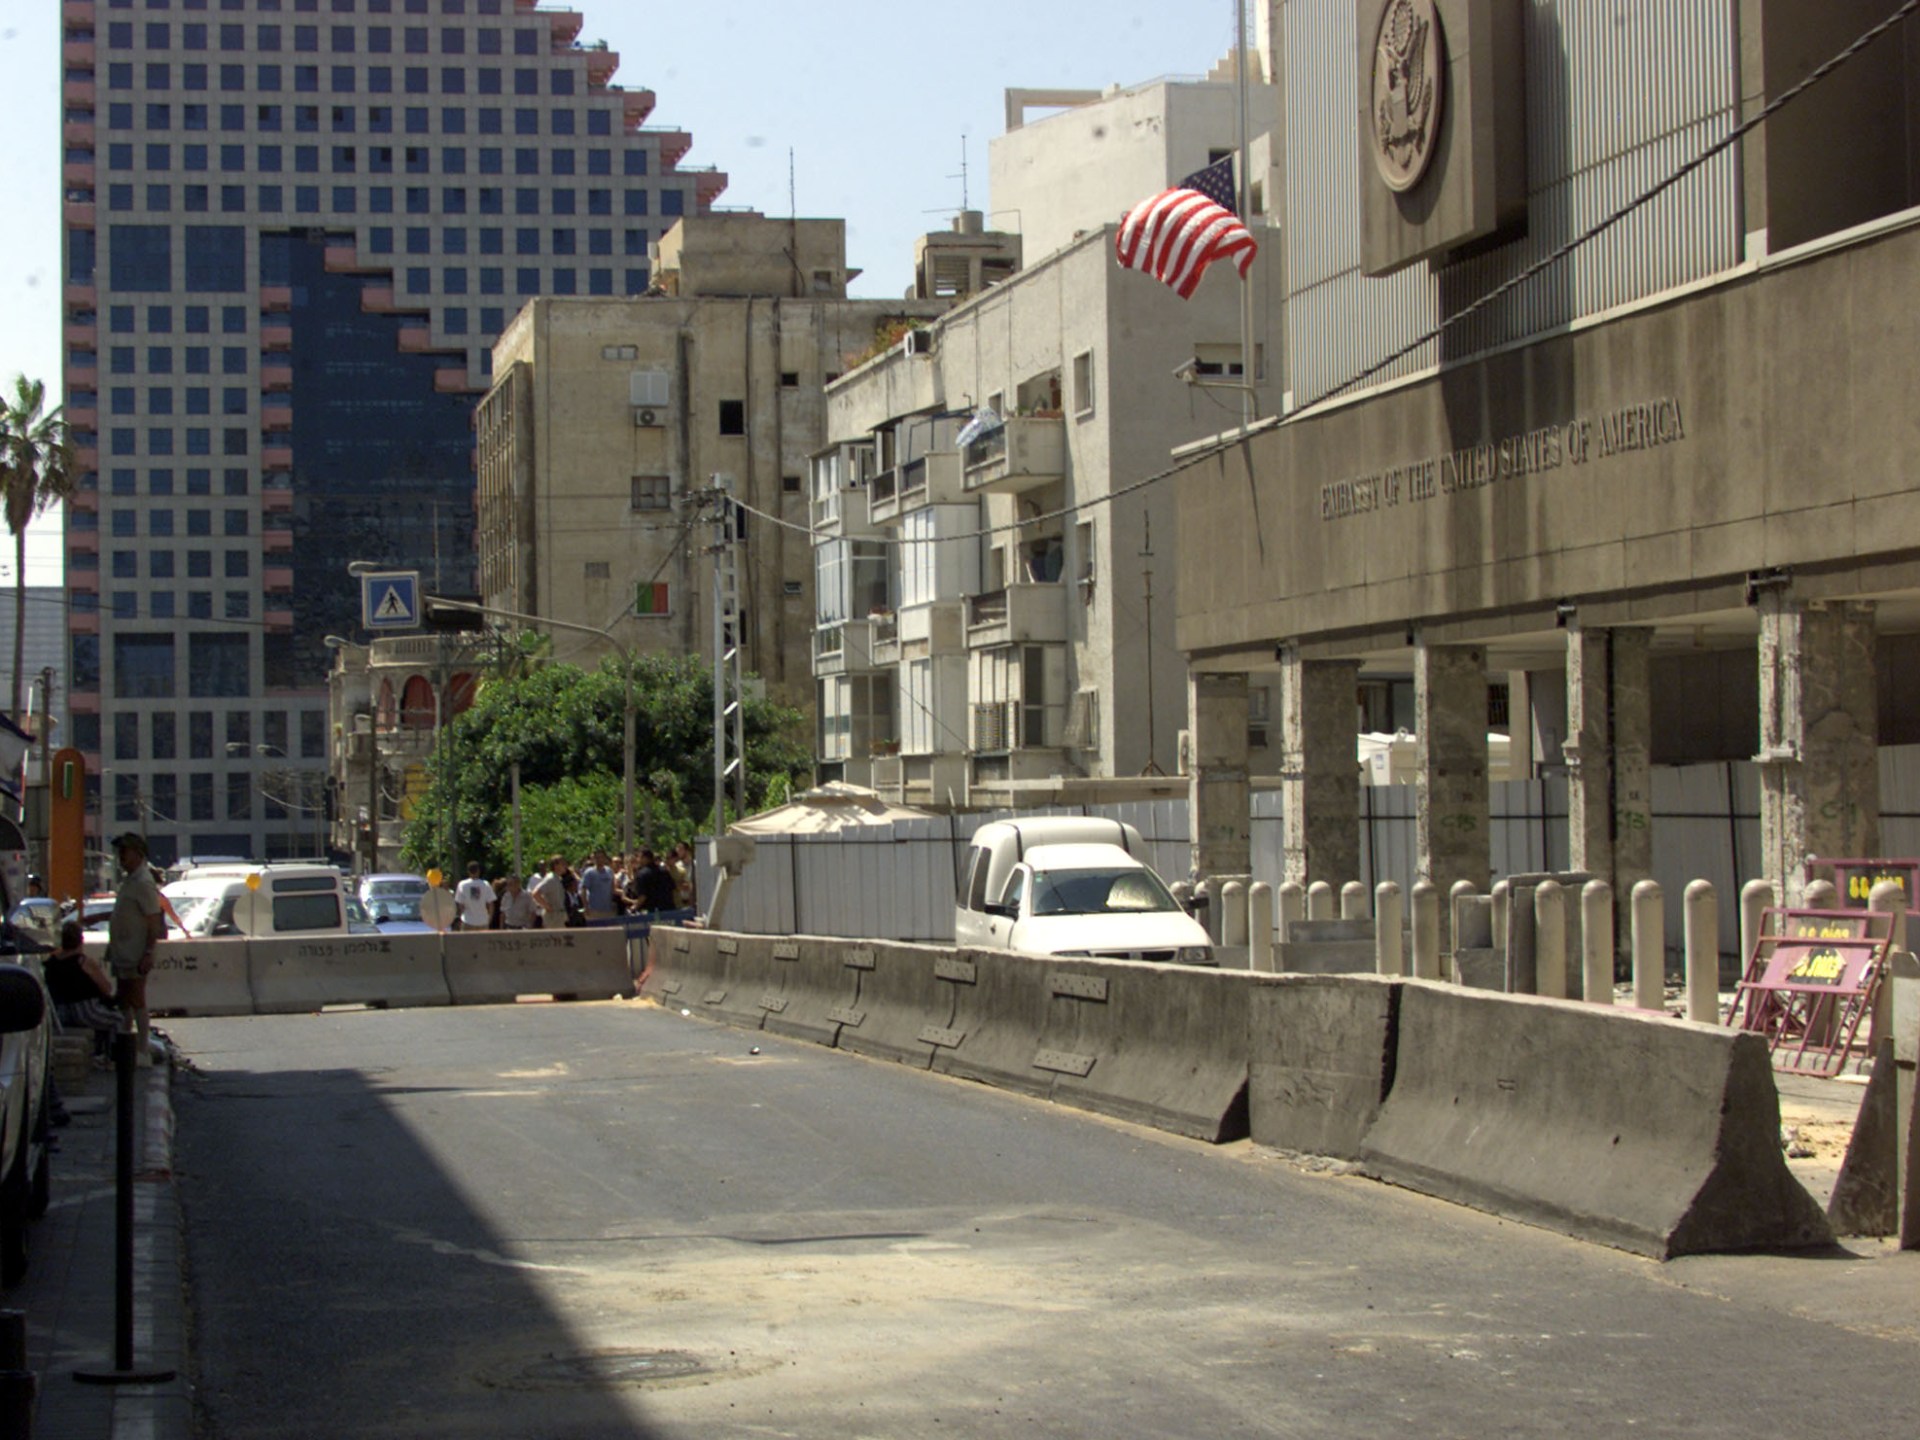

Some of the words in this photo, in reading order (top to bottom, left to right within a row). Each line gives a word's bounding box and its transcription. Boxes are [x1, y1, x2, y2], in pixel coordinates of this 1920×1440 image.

[1321, 476, 1380, 521] EMBASSY
[1384, 467, 1402, 507] OF
[1407, 458, 1436, 503] THE
[1440, 442, 1498, 495] UNITED
[1500, 424, 1563, 480] STATES
[1567, 417, 1592, 465] OF
[1598, 396, 1686, 458] AMERICA
